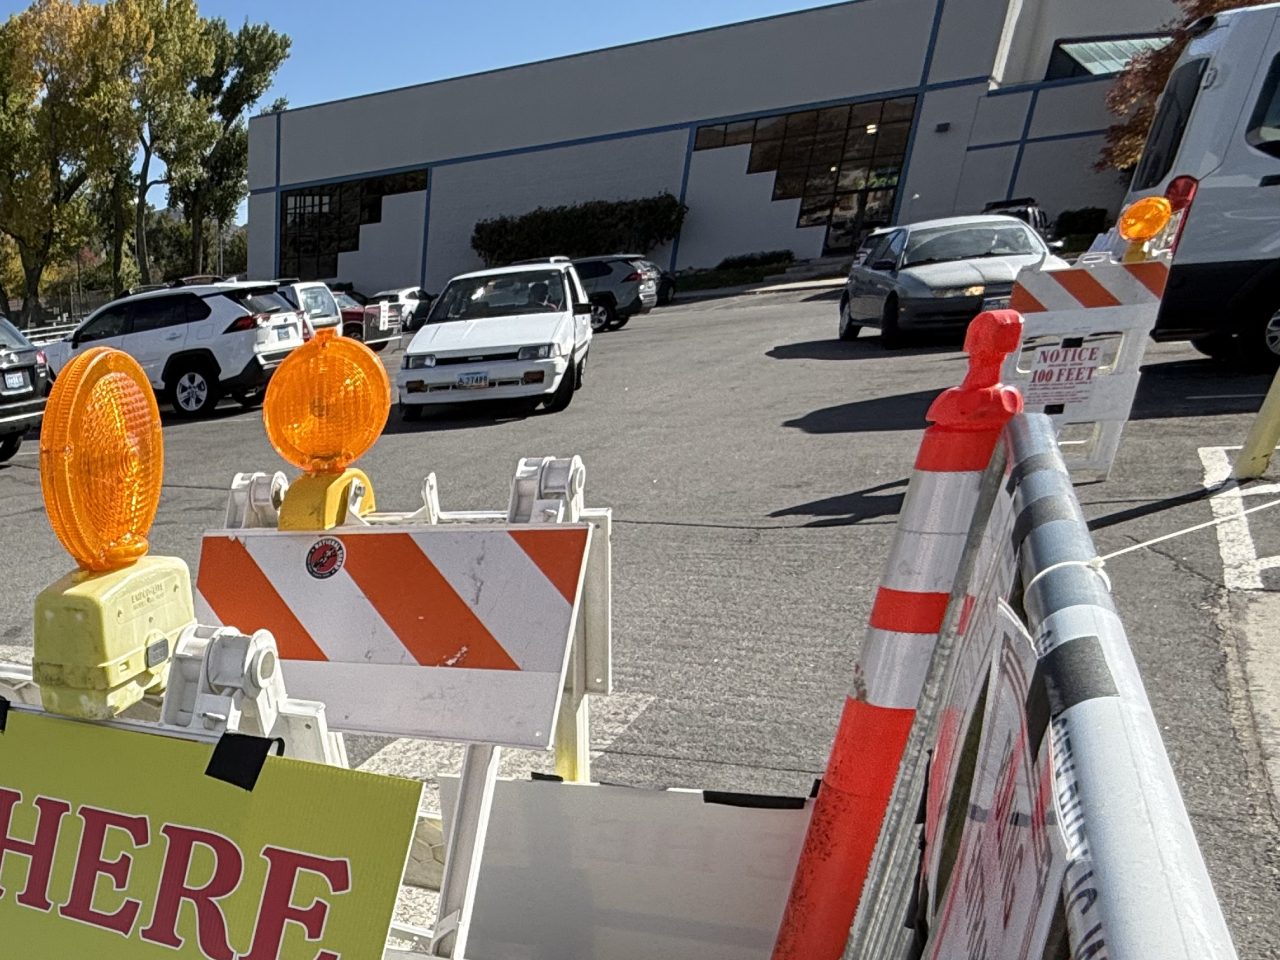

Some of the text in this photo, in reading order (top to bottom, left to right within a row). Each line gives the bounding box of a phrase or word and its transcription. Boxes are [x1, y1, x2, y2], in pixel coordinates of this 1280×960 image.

[1037, 347, 1100, 364] NOTICE
[1030, 366, 1097, 384] 100 FEET
